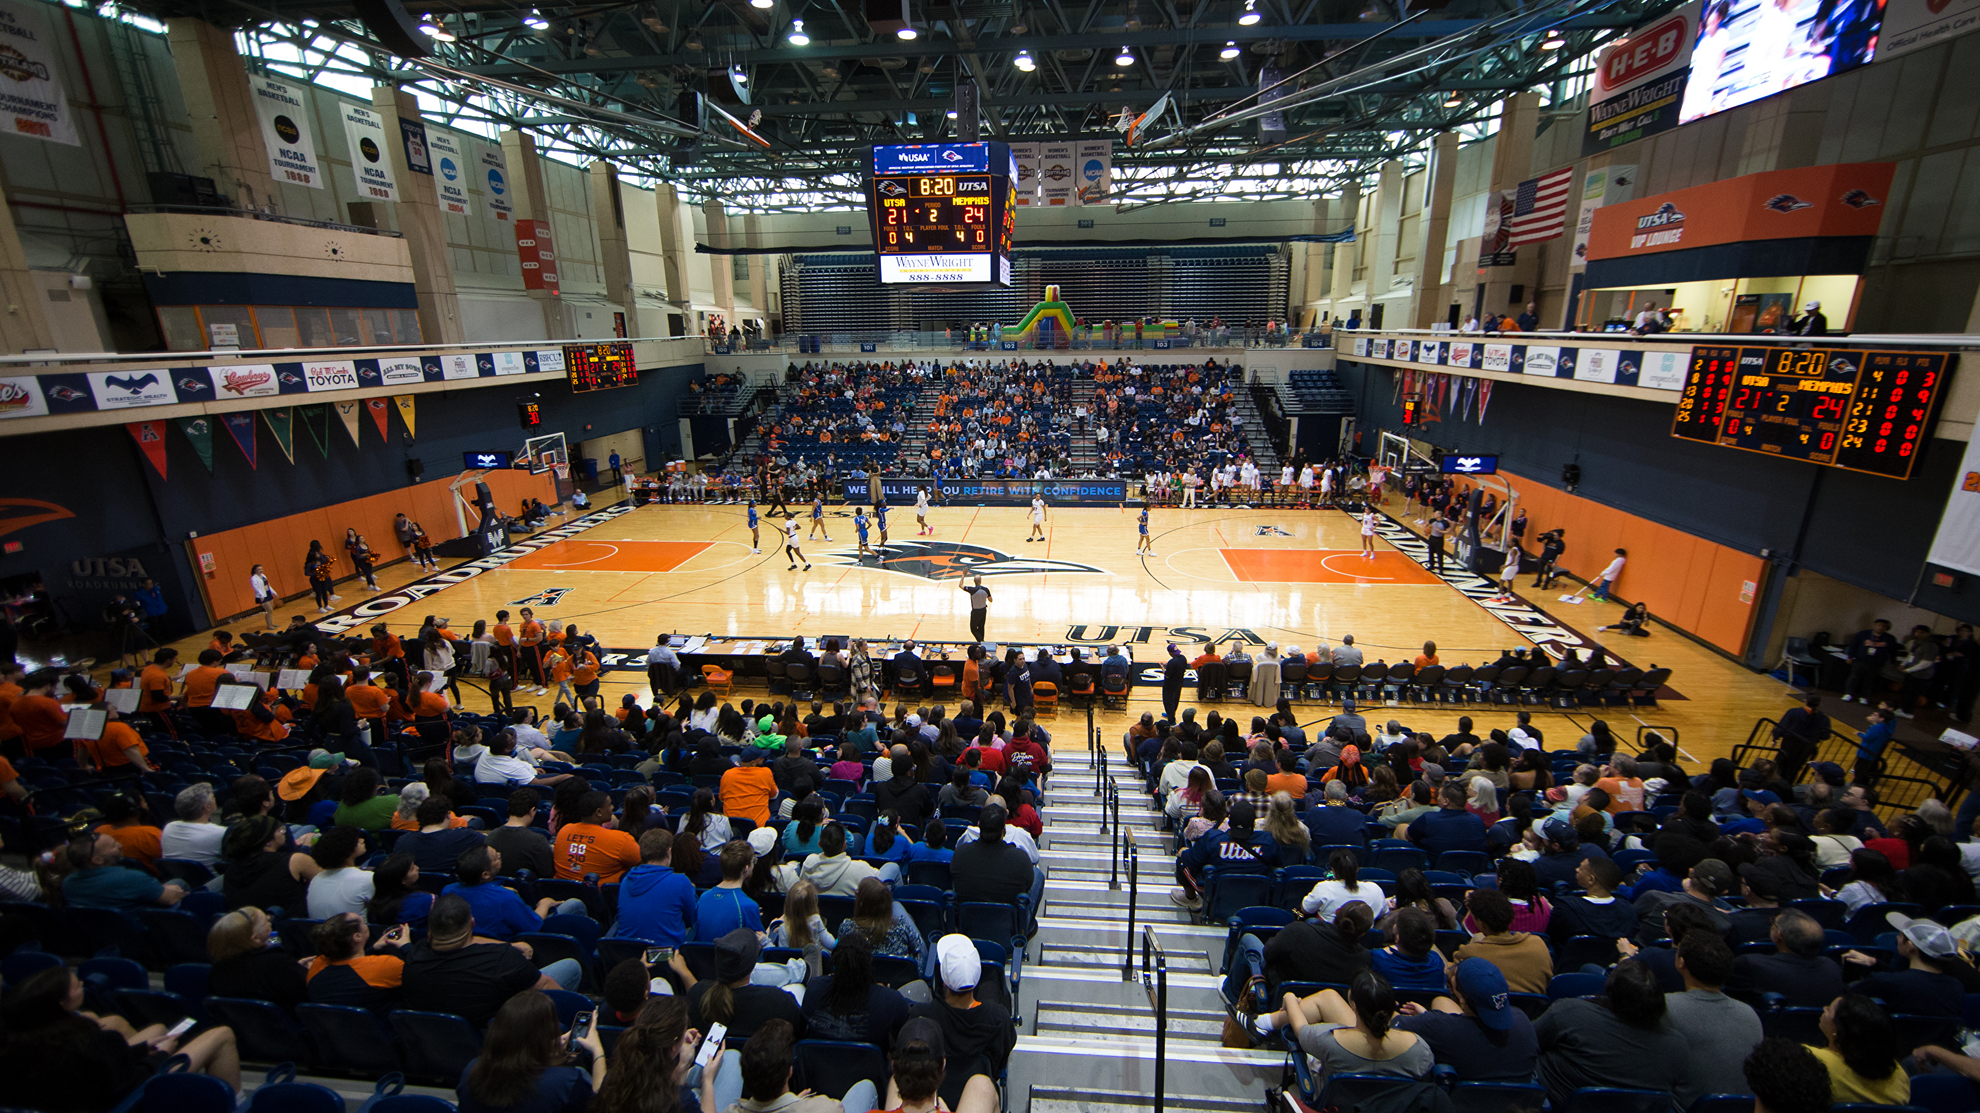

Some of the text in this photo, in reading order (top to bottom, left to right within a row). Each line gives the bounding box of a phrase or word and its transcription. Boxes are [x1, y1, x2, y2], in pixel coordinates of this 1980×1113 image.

[266, 81, 287, 94] MEN'S
[258, 88, 300, 106] BASKETBALL
[354, 108, 370, 118] MEN'S
[346, 114, 381, 129] BASKETBALL
[279, 148, 307, 163] NCAA
[273, 159, 316, 174] TOURNAMENT
[364, 167, 386, 179] NCAA
[360, 176, 394, 189] TOURNAMENT
[920, 178, 953, 196] 8:20
[958, 182, 988, 192] UTSA
[444, 186, 462, 196] NCAA
[440, 194, 468, 204] TOURNAMENT
[884, 199, 905, 207] UTSA
[953, 197, 989, 206] MEMPHIS
[888, 209, 907, 225] 21
[930, 209, 938, 222] 2
[965, 207, 984, 223] 24
[1638, 213, 1668, 228] UTSA
[889, 232, 897, 244] 0
[905, 232, 913, 243] 4
[956, 231, 964, 242] 4
[976, 230, 984, 242] 0
[1630, 228, 1684, 249] VIP LOUNGE
[1484, 356, 1508, 367] TOYOTA
[1694, 359, 1703, 370] 2
[1740, 357, 1763, 365] UTSA
[1777, 352, 1825, 374] 8:20
[382, 364, 394, 376] ALL
[395, 363, 404, 371] MY
[405, 364, 421, 373] SONS
[308, 374, 356, 386] TOYOTA
[1742, 375, 1770, 387] UTSA
[1798, 380, 1854, 395] MEMPHIS
[1735, 388, 1761, 409] 21
[1776, 395, 1790, 412] 2
[1812, 396, 1845, 419] 24
[528, 412, 540, 425] 30
[1847, 419, 1868, 433] 23
[1842, 434, 1863, 448] 24
[848, 486, 1121, 495] WE ILL HEP OU RETIRE WITH CONFIDENCE
[72, 557, 148, 578] UTSA
[316, 506, 636, 634] ROADRUNNERS
[67, 580, 161, 589] ROADRUNNS
[1066, 625, 1267, 646] UTSA
[567, 834, 595, 844] LET'S
[569, 843, 586, 855] GO
[568, 854, 586, 862] 210
